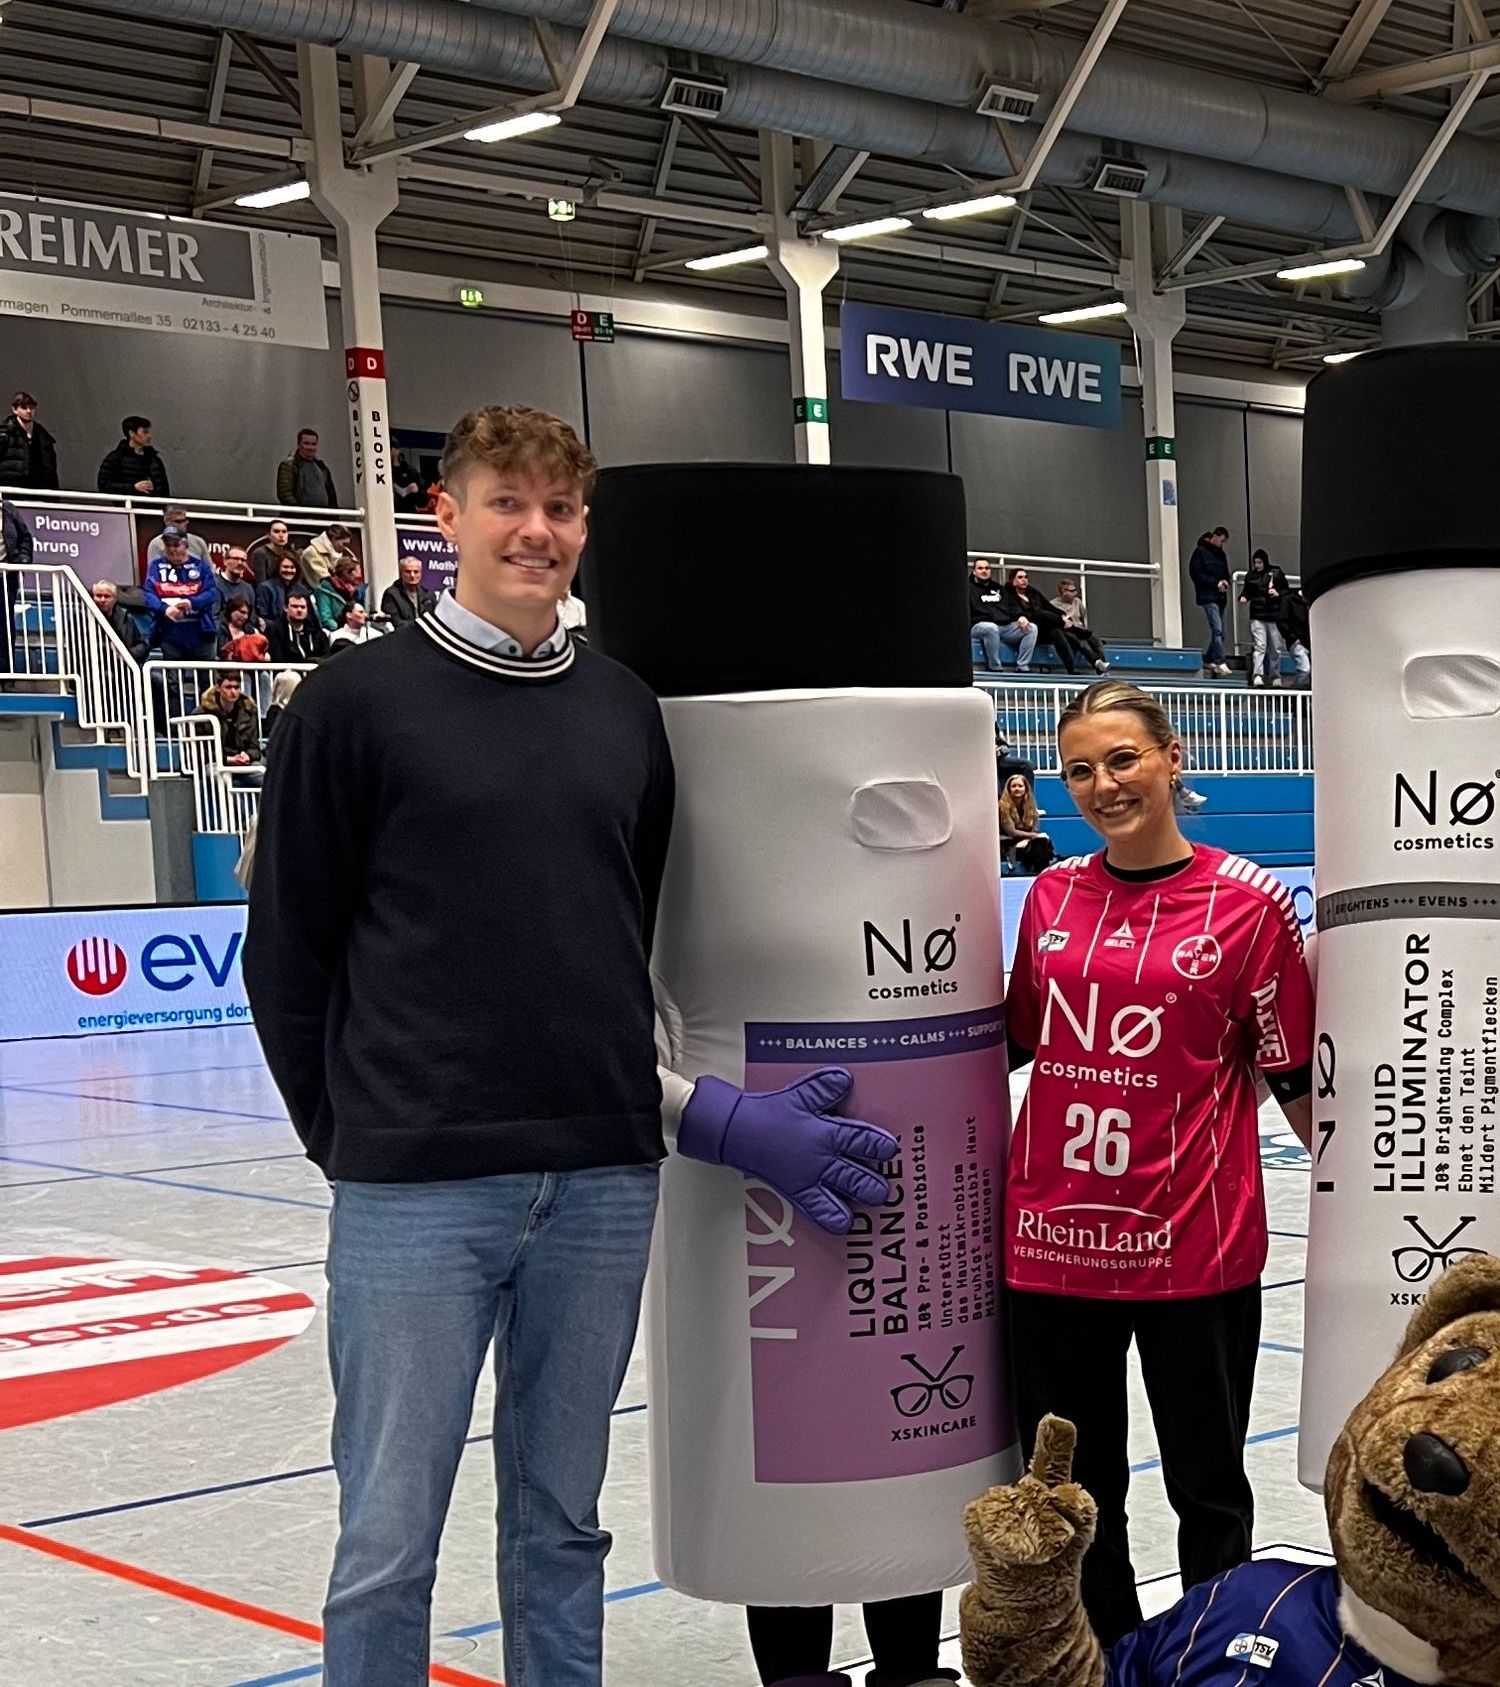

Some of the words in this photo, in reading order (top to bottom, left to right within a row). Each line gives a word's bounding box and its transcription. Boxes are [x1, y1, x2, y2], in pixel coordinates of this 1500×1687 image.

[156, 314, 172, 327] 35
[183, 318, 221, 332] 02133
[231, 324, 239, 335] 4
[242, 324, 258, 338] 25
[260, 326, 276, 339] 40
[577, 312, 587, 325] D
[600, 314, 609, 327] E
[367, 357, 378, 370] D
[866, 334, 974, 387] RWE
[1008, 352, 1102, 402] RWE
[813, 404, 823, 418] E
[371, 410, 386, 485] BLOCK
[1164, 443, 1171, 454] E
[35, 514, 100, 535] Planung
[1393, 832, 1494, 851] cosmetics
[1418, 896, 1467, 908] EVENS
[868, 978, 958, 1000] cosmetics
[1437, 969, 1454, 1038] Complex
[77, 1005, 223, 1029] energieversorgung
[785, 1037, 868, 1049] BALANCES
[899, 1031, 946, 1046] CALMS
[1481, 976, 1500, 1115] Pigmentflecken
[1039, 1056, 1159, 1089] cosmetics
[1400, 933, 1431, 1192] ILLUMINATOR
[1460, 1047, 1476, 1096] Teint
[1436, 1046, 1454, 1155] Brightening
[966, 1115, 977, 1154] Haut
[1062, 1102, 1131, 1177] 26
[1373, 1063, 1397, 1192] LIQUID
[1462, 1113, 1475, 1135] den
[1458, 1146, 1474, 1193] Ebnet
[1479, 1124, 1496, 1194] Mildert
[912, 1125, 928, 1230] Postbiotics
[1435, 1163, 1449, 1192] 10%
[878, 1134, 909, 1335] BALANCE
[953, 1163, 969, 1288] Hautmikrobiom
[1016, 1208, 1173, 1253] RheinLand
[1013, 1244, 1173, 1270] VERSICHERUNGSGRUPPE
[847, 1211, 876, 1338] LIQUID
[958, 1296, 969, 1324] das
[891, 1415, 977, 1442] XSKINCARE
[1254, 1641, 1276, 1656] TSV
